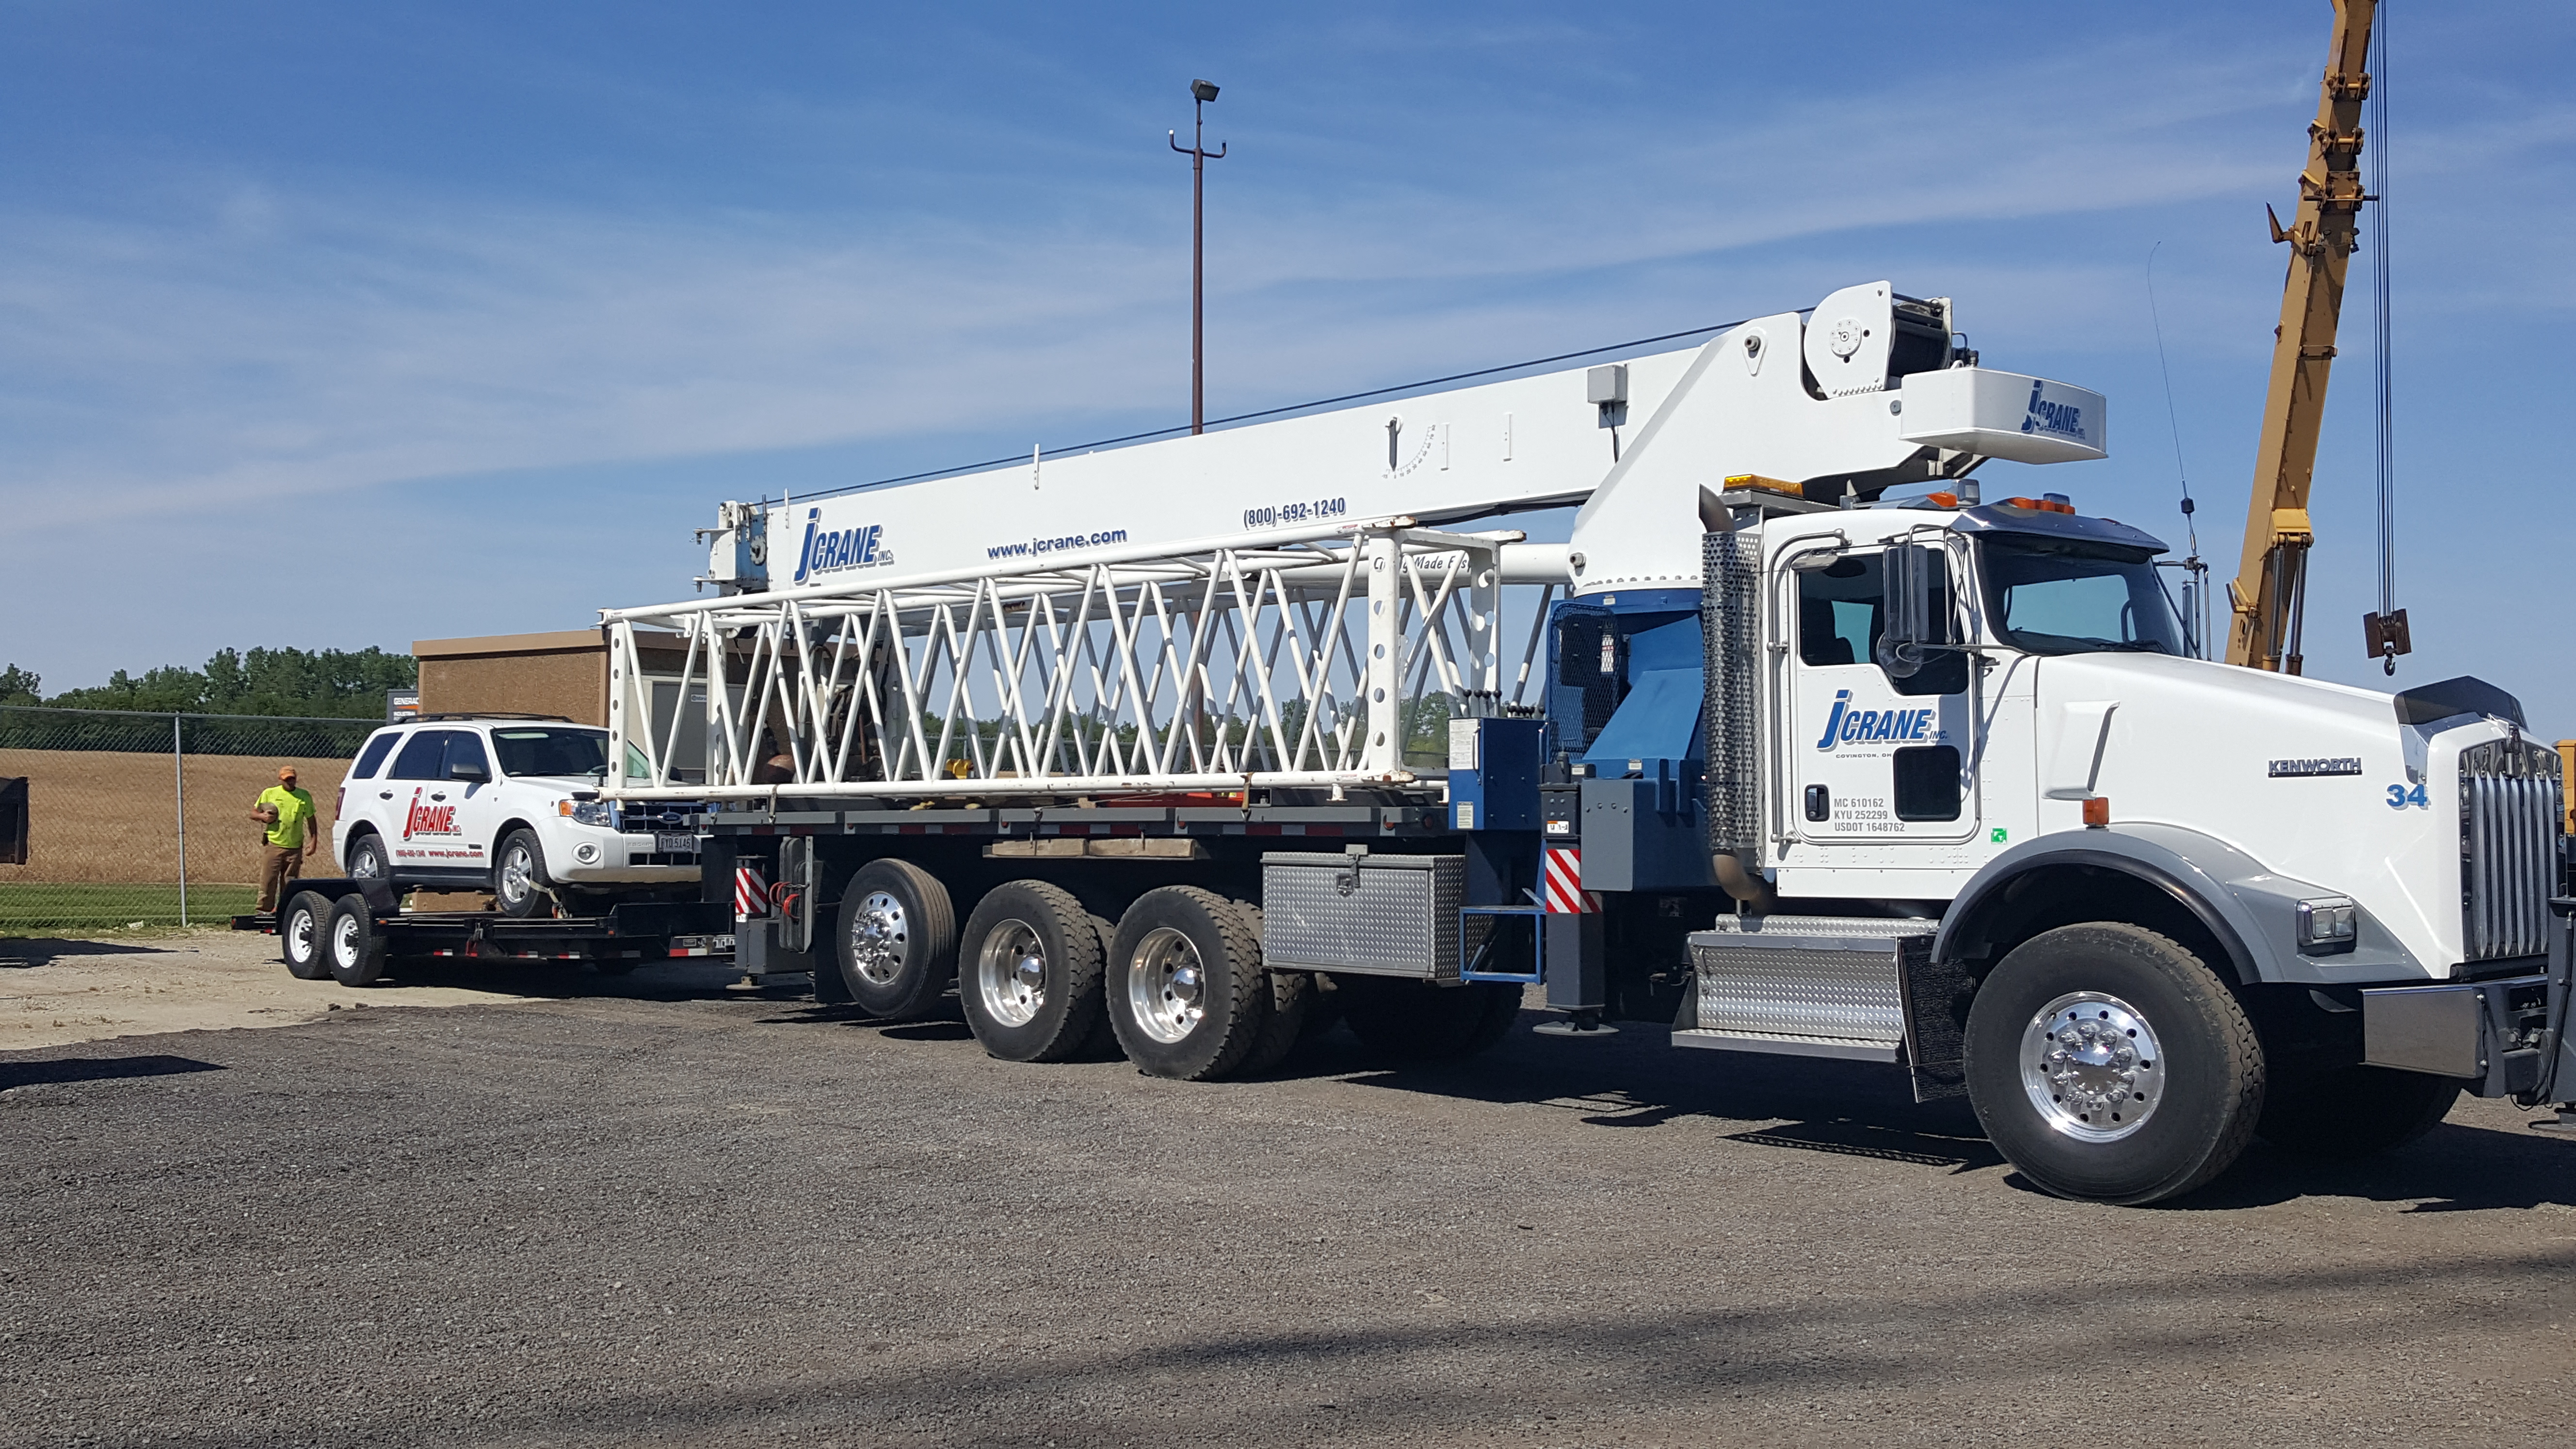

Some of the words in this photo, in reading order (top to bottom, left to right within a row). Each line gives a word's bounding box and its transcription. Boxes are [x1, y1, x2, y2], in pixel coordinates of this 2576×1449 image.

[1244, 497, 1346, 530] (800)-692-1240
[987, 529, 1127, 559] www.jcrane.com
[1414, 556, 1443, 569] Made
[1929, 730, 1948, 740] INC.
[2269, 757, 2362, 773] KENWORTH
[1834, 798, 1848, 807] MC
[1851, 798, 1884, 807] 610162
[2386, 784, 2430, 809] 34
[1835, 810, 1852, 820] KYU
[1855, 810, 1888, 820] 252299
[1835, 822, 1863, 831] USDOT
[1867, 822, 1905, 832] 1648762
